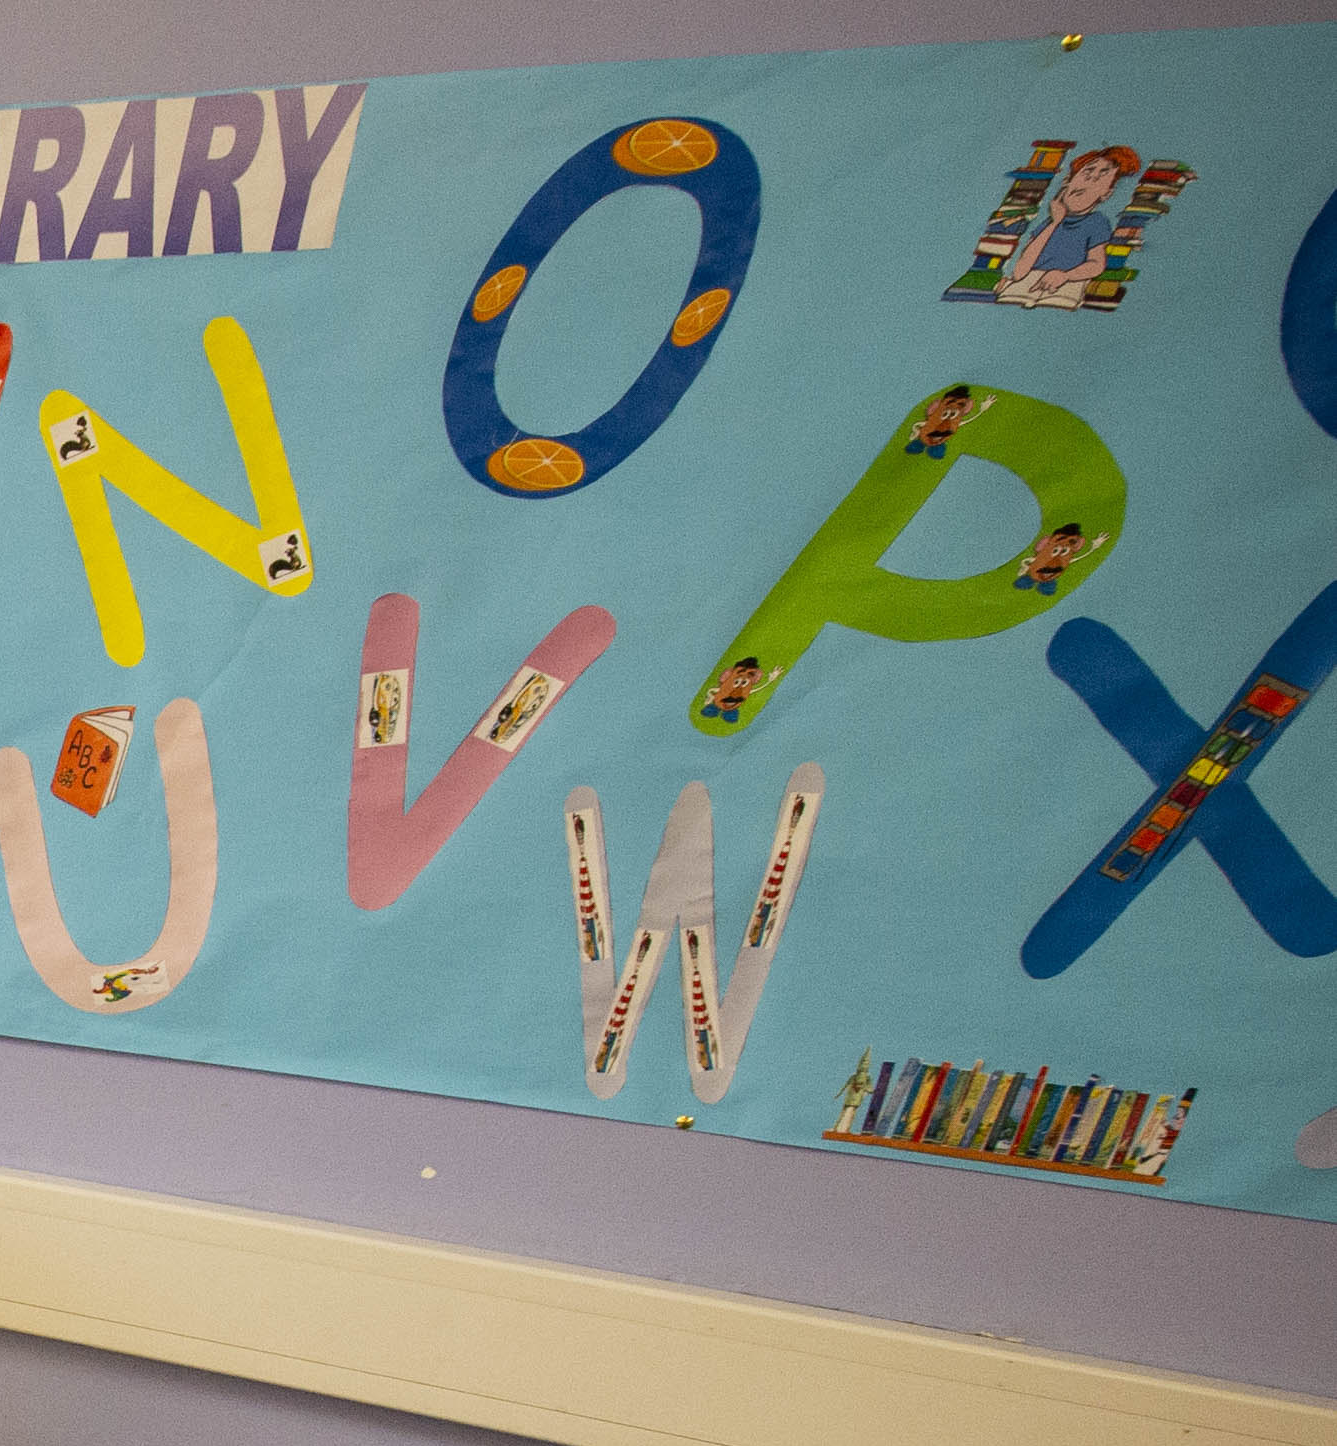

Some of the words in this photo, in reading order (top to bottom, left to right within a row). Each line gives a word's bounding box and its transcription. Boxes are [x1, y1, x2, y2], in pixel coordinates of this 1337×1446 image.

[39, 316, 314, 668] N
[689, 384, 1127, 737] P
[348, 593, 617, 911] V
[564, 762, 826, 1104] W
